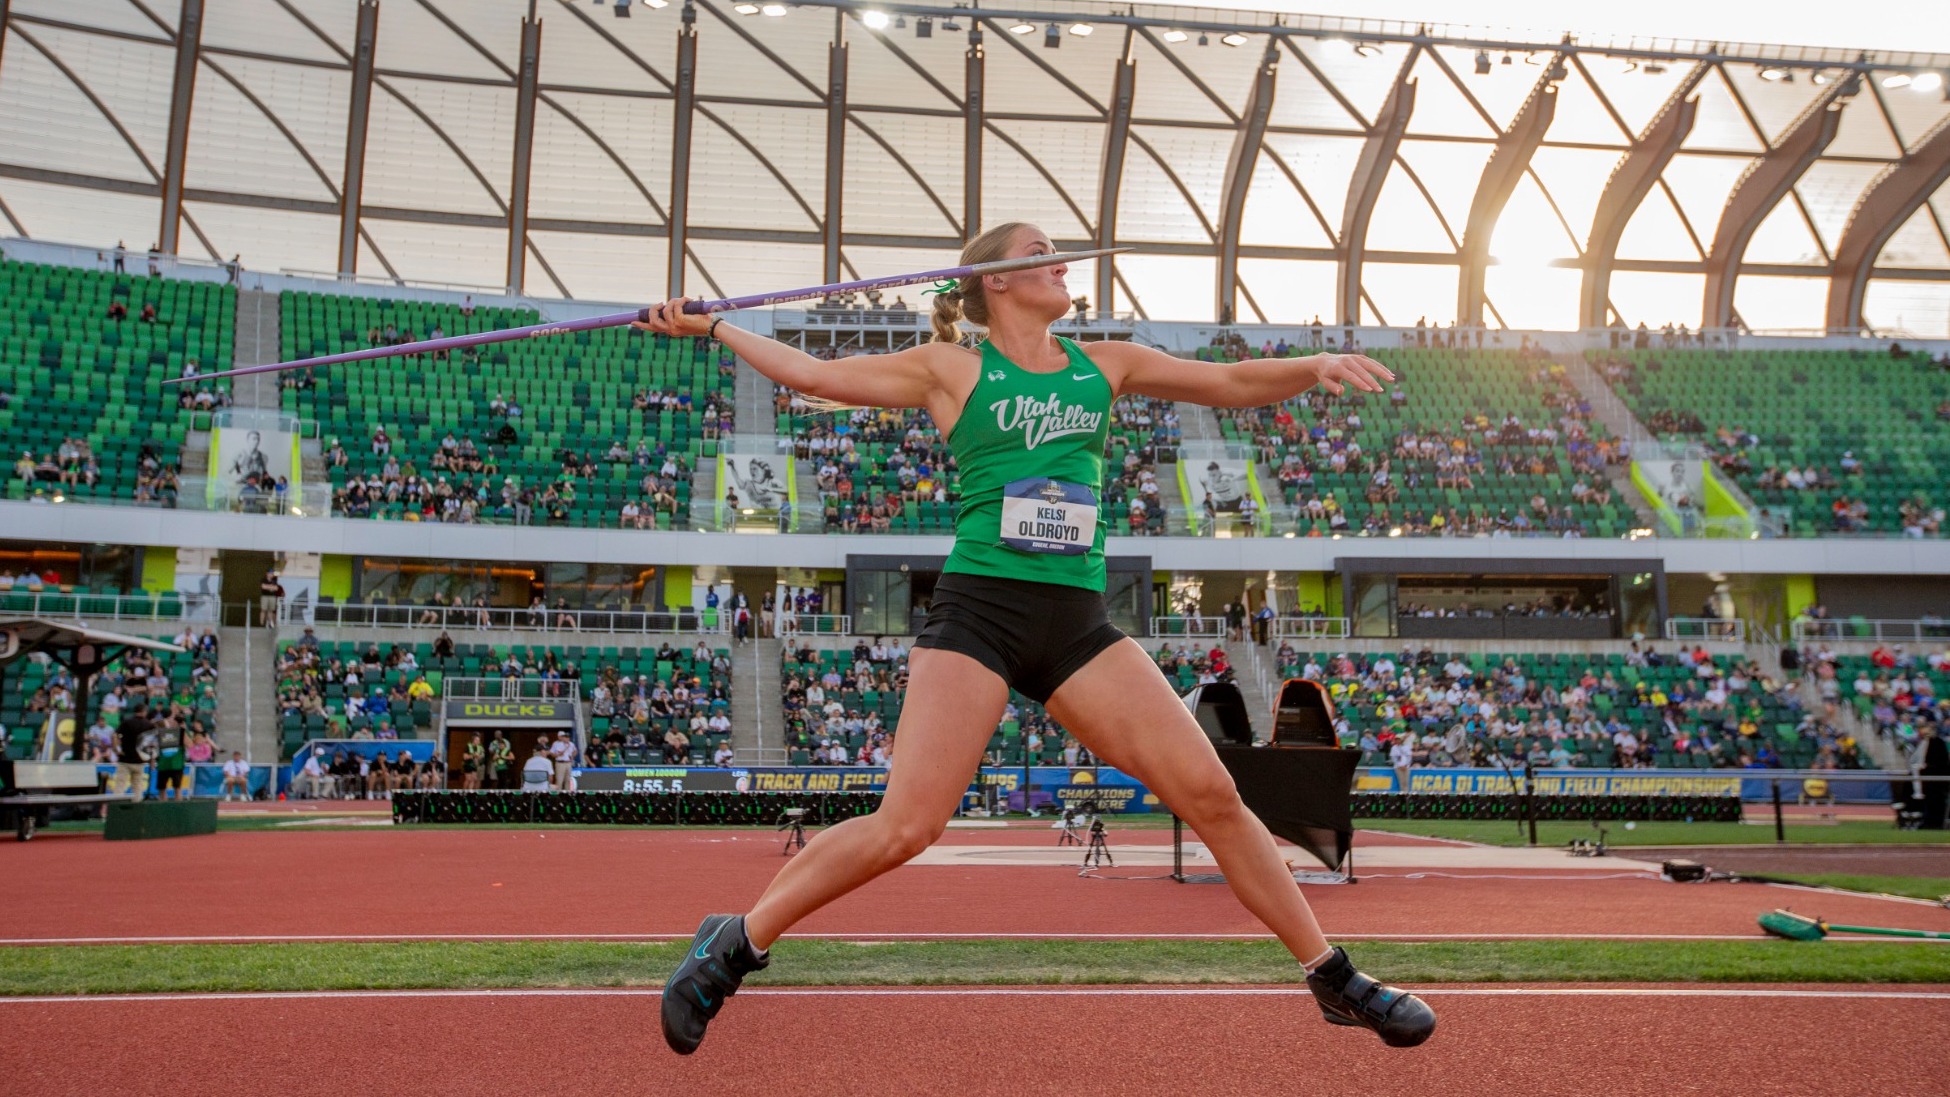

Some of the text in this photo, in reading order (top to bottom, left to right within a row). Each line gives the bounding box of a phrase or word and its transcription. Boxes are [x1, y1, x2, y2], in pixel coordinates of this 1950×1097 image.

[989, 392, 1063, 432] Utah
[1017, 404, 1102, 450] Valley
[1036, 506, 1067, 522] KELSI
[1018, 520, 1080, 541] OLDROYD
[464, 703, 555, 717] DUCKS
[755, 773, 805, 790] TRACK
[806, 773, 840, 790] AND
[1411, 775, 1453, 792] NCAA
[1476, 775, 1526, 792] TRACK
[1564, 776, 1607, 793] FIELD
